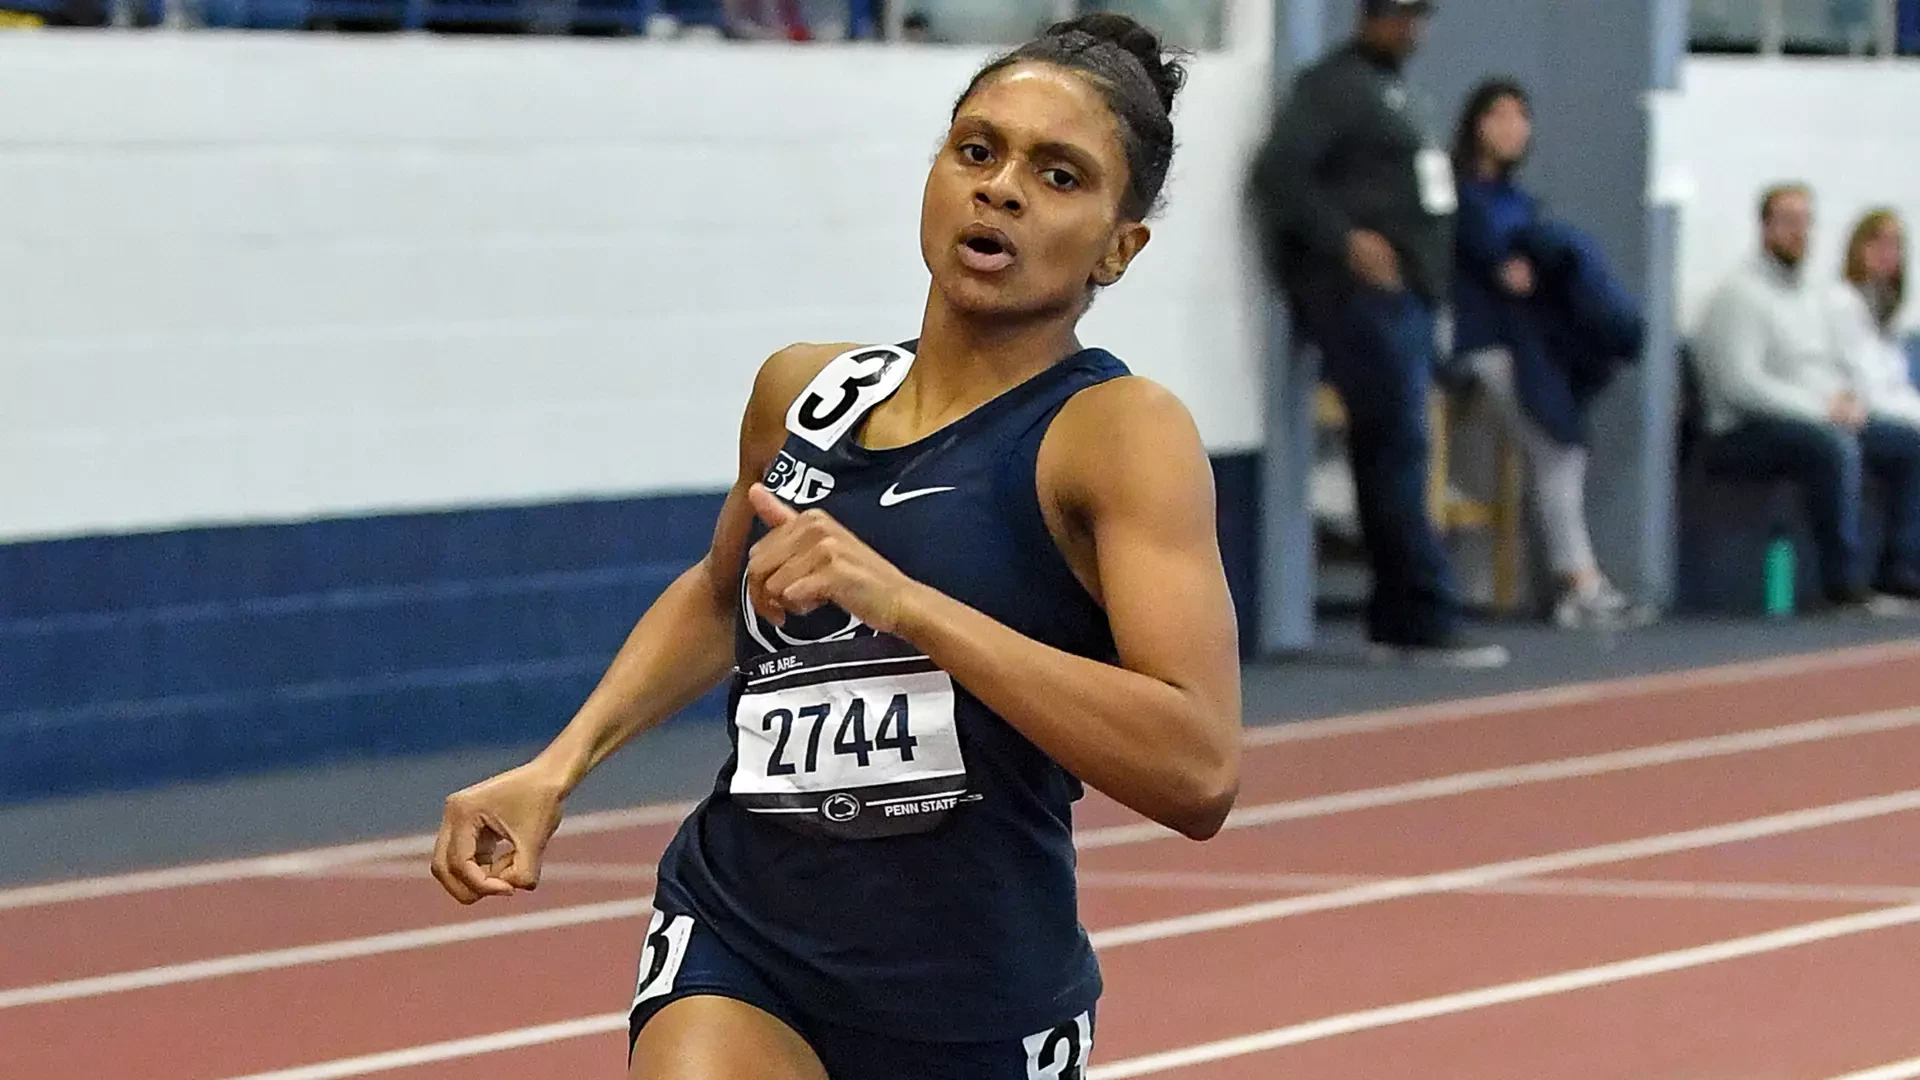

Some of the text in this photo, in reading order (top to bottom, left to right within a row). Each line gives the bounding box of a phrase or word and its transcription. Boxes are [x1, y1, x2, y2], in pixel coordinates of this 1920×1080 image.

[798, 350, 901, 431] 3
[759, 661, 776, 675] WE
[762, 693, 918, 777] 2744
[884, 804, 919, 817] PENN
